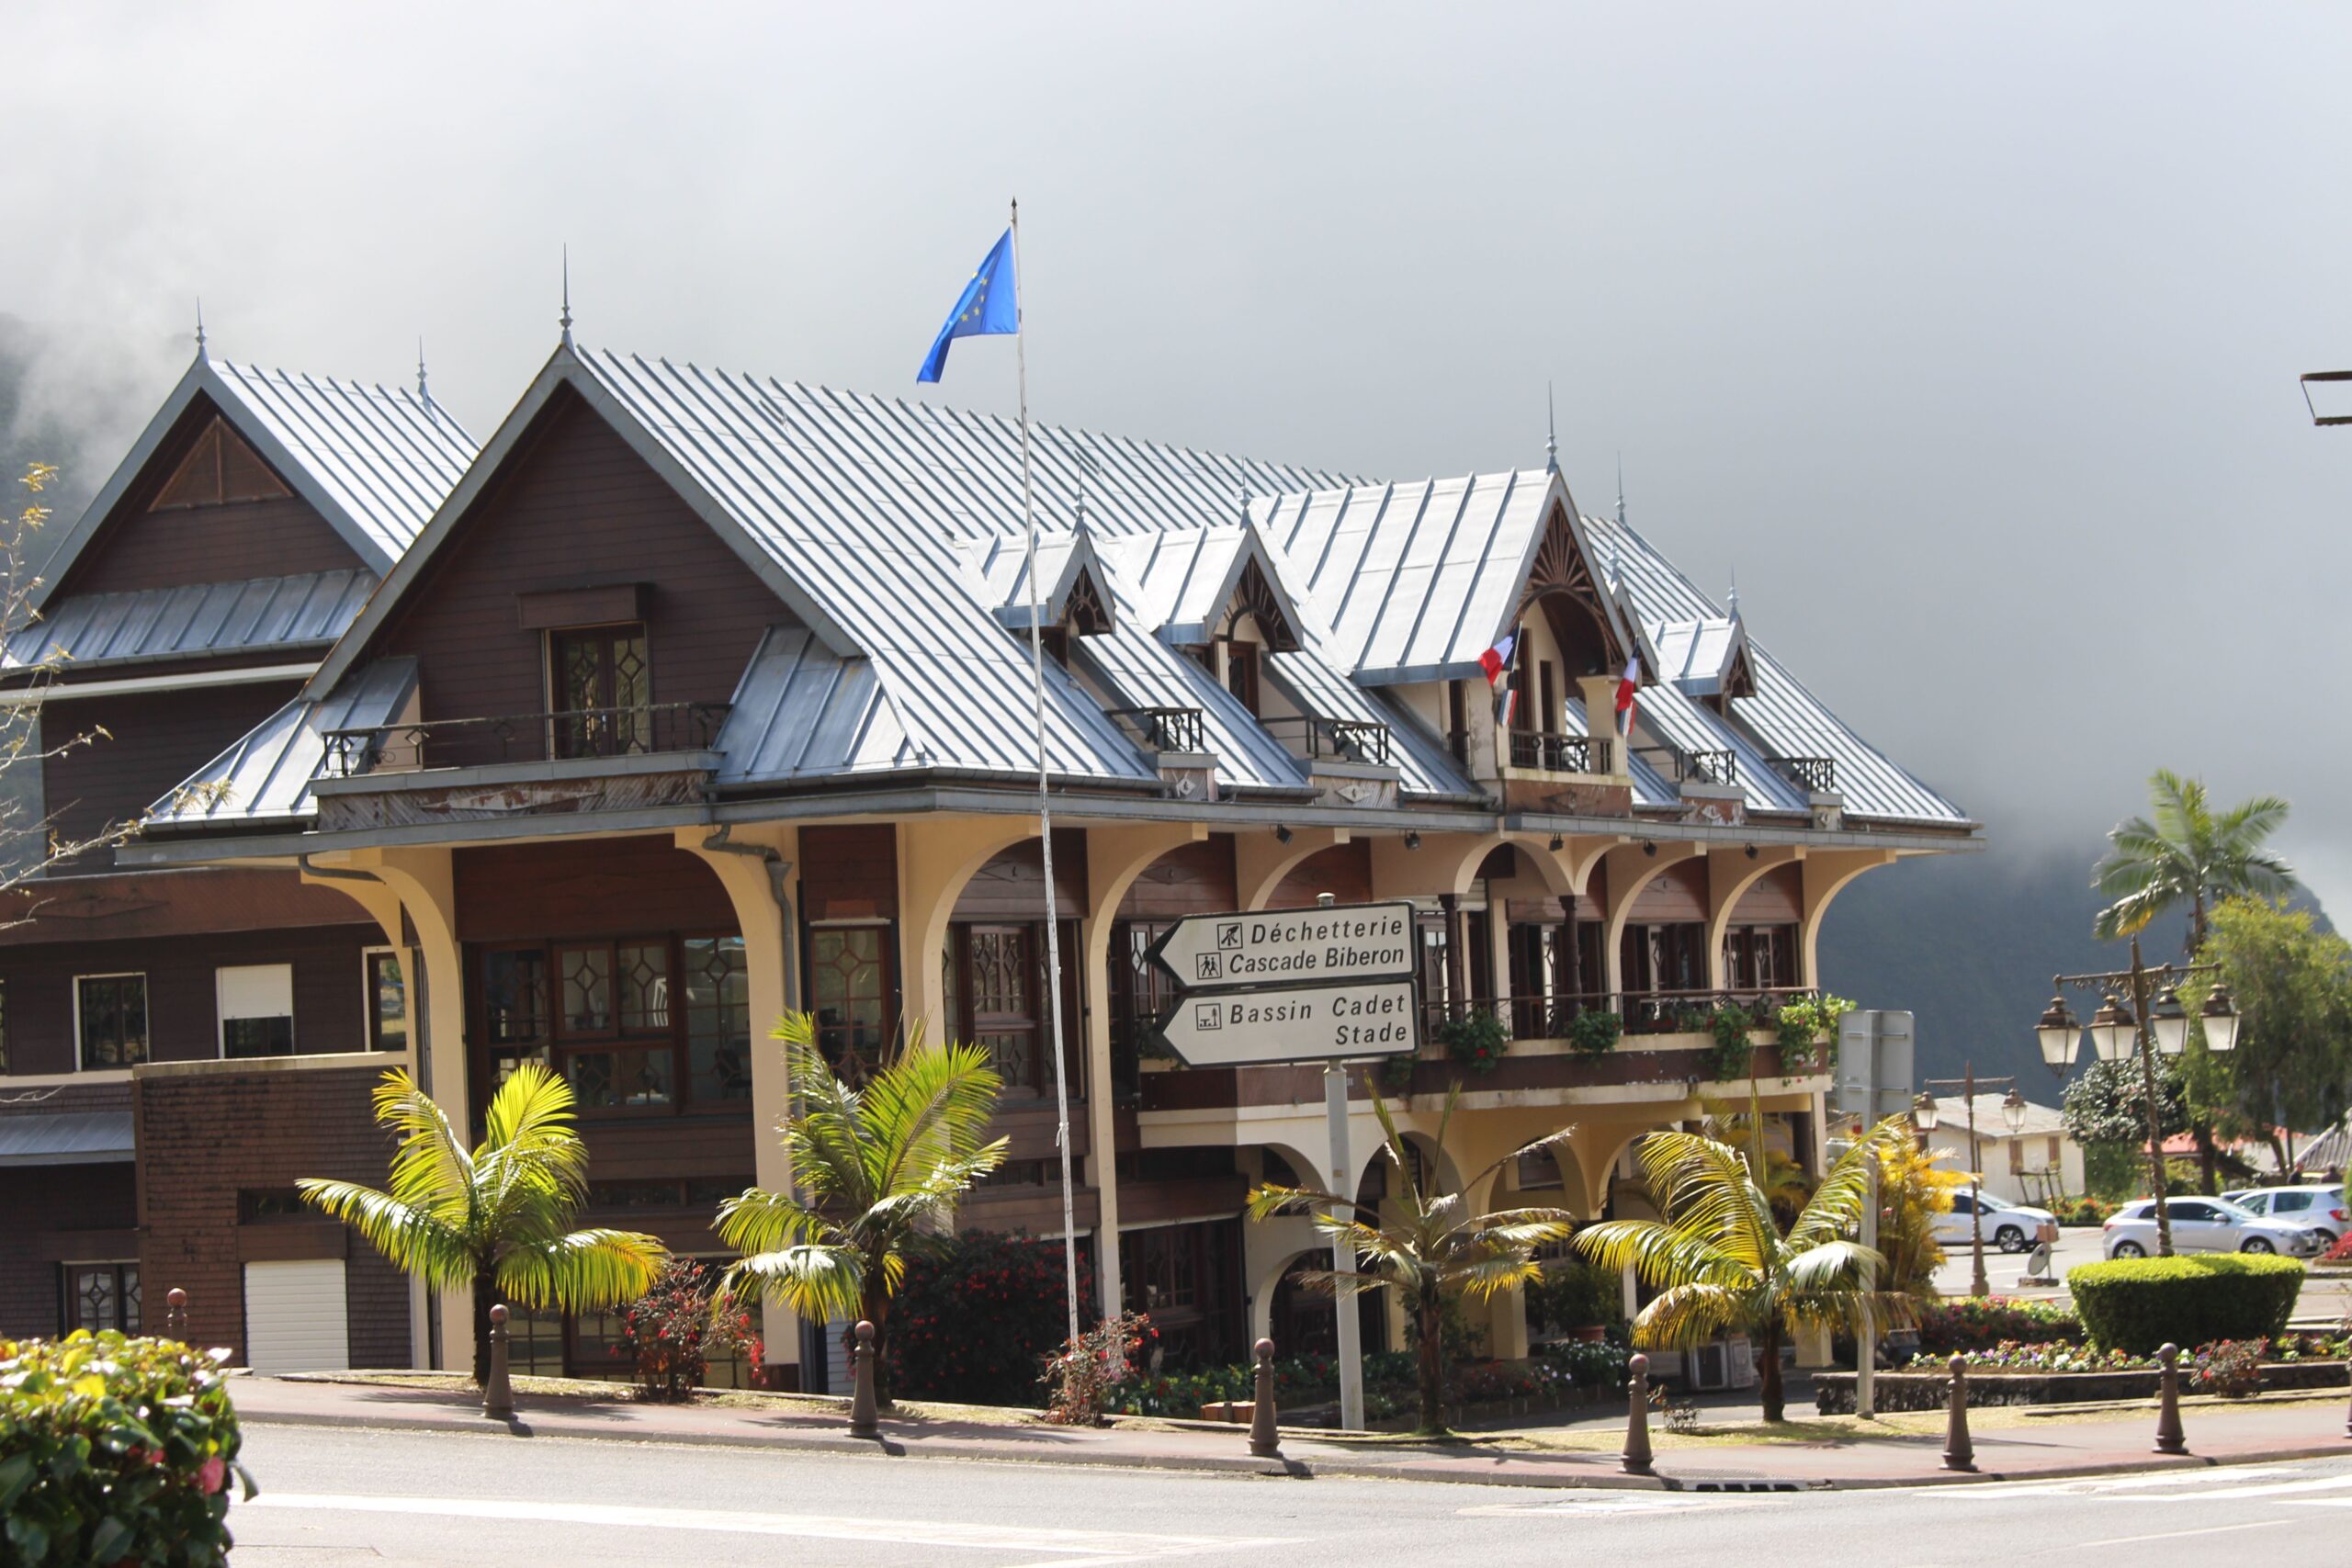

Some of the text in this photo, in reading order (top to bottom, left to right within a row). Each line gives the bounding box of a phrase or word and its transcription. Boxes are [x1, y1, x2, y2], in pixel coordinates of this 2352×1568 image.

[1250, 916, 1403, 944] Déchetterie
[1229, 946, 1405, 975] Cascade Biberon
[1229, 994, 1405, 1024] Bassin Cadet
[1335, 1021, 1408, 1045] Stade
